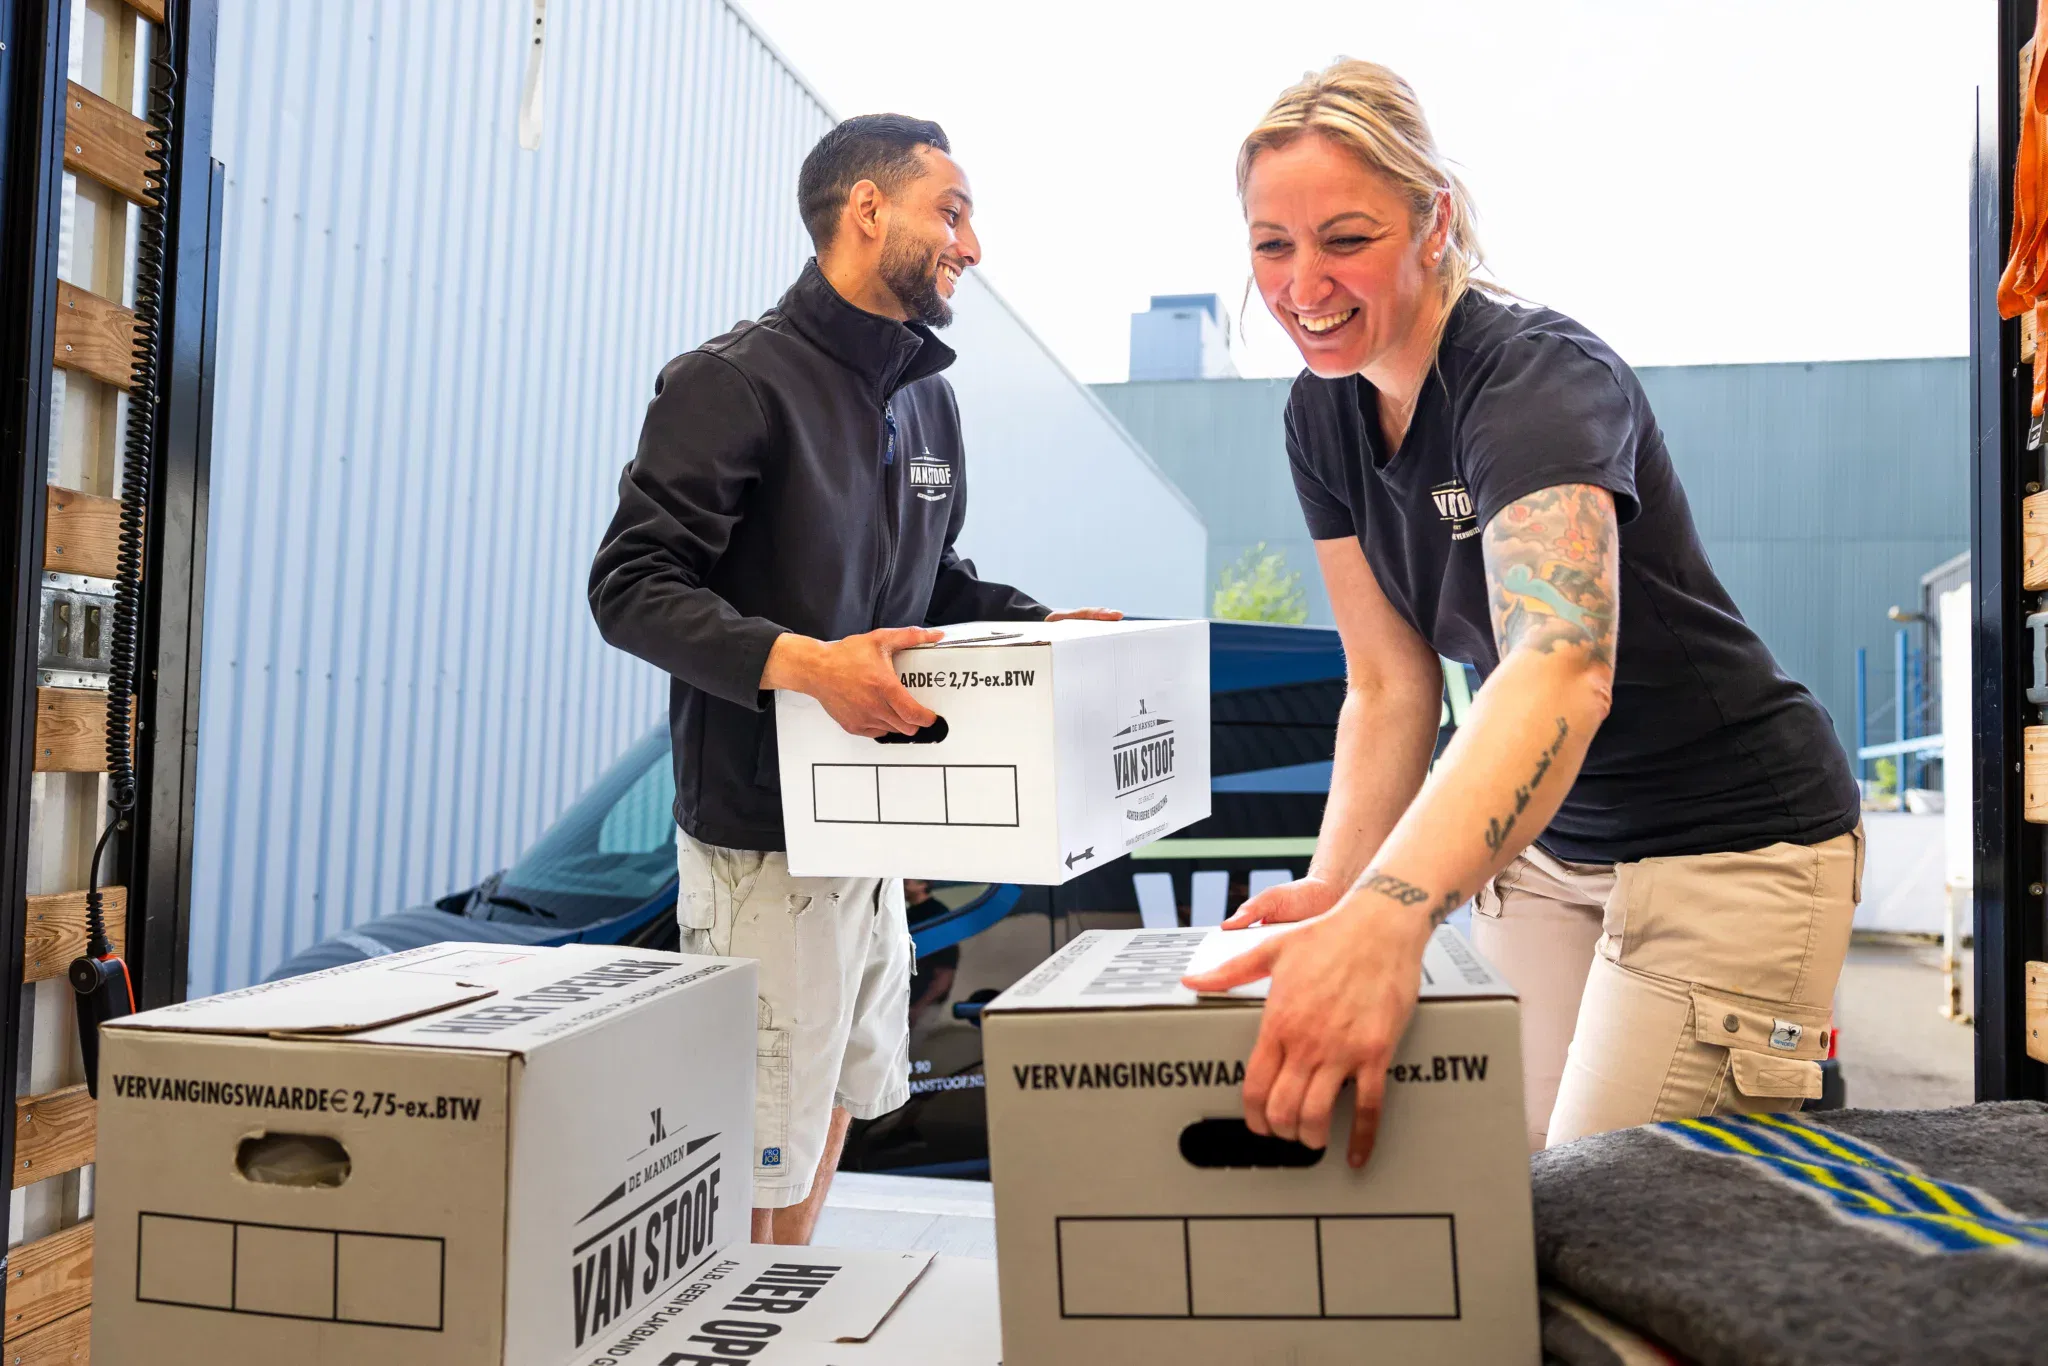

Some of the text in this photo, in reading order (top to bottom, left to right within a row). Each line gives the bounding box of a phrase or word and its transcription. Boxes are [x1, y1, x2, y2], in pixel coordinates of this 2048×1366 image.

[900, 670, 1035, 690] ARDE€ 2,75-ex.BTW
[1113, 737, 1175, 791] VAN STOOF
[411, 1004, 565, 1036] HIER
[513, 958, 684, 1003] OPENEN
[1012, 1055, 1488, 1091] VERVANGINGSWAA -ex.BTW
[628, 1145, 685, 1194] DE MANNEN
[763, 1155, 779, 1164] JOB
[572, 1167, 721, 1350] VAN STOOF
[699, 1259, 741, 1282] A.U.B.
[657, 1262, 843, 1366] HIER OPE
[670, 1282, 712, 1307] GEEN
[606, 1305, 684, 1358] PLAKBAND
